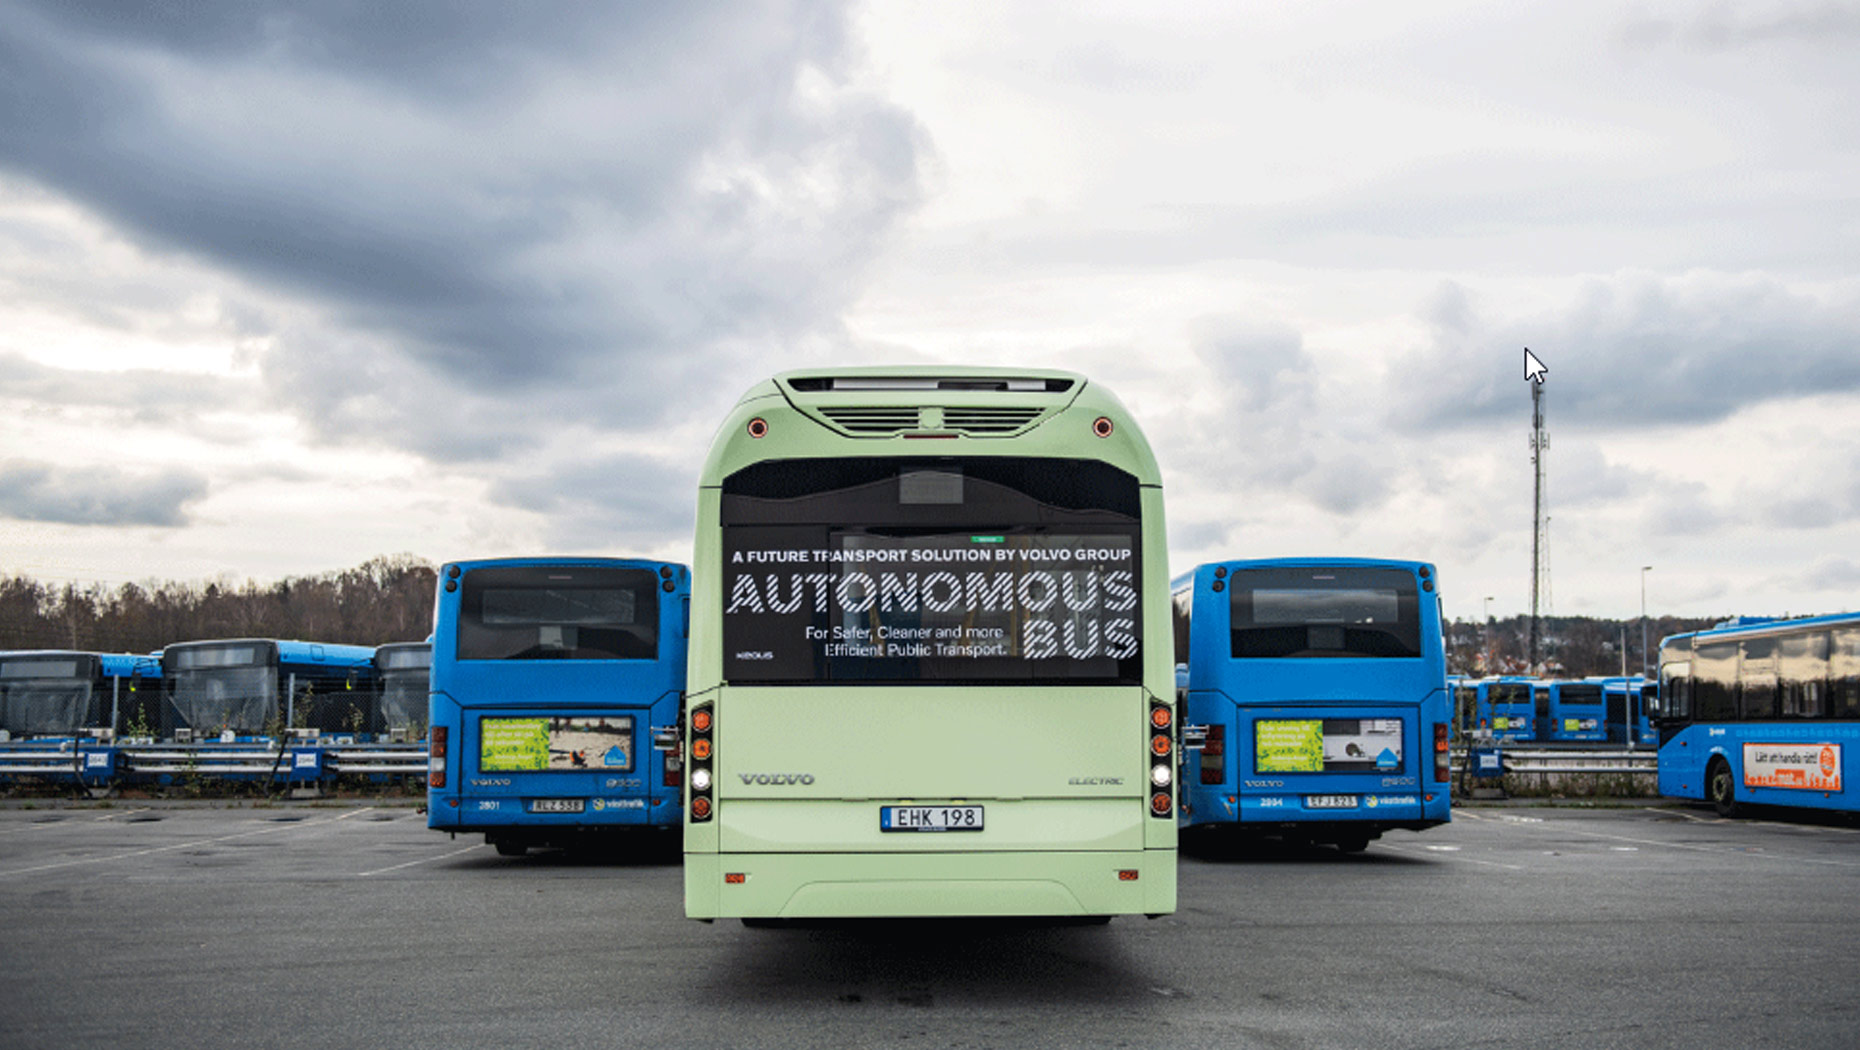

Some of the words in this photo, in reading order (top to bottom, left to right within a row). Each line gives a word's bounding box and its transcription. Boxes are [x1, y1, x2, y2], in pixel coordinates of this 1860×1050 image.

[732, 551, 744, 563] A
[748, 550, 809, 563] FUTURE
[812, 549, 908, 562] TRANSPORT
[911, 549, 991, 562] SOLUTION
[995, 549, 1016, 561] BY
[1019, 549, 1071, 561] VOLVO
[1075, 548, 1131, 561] GROUP
[726, 570, 1138, 614] AUTONOMOUS
[806, 626, 830, 640] For
[833, 625, 874, 642] Safer,
[877, 625, 932, 639] Cleaner
[935, 625, 962, 639] and
[966, 627, 1004, 639] more
[1023, 618, 1139, 660] BUS
[825, 643, 884, 657] Efficient
[887, 643, 932, 657] Public
[936, 643, 1008, 659] Transport.
[470, 778, 512, 786] VOLVO
[738, 773, 815, 785] VOLVO
[1068, 776, 1126, 786] ELECTRIC
[898, 809, 933, 826] EHK
[941, 809, 976, 826] 198
